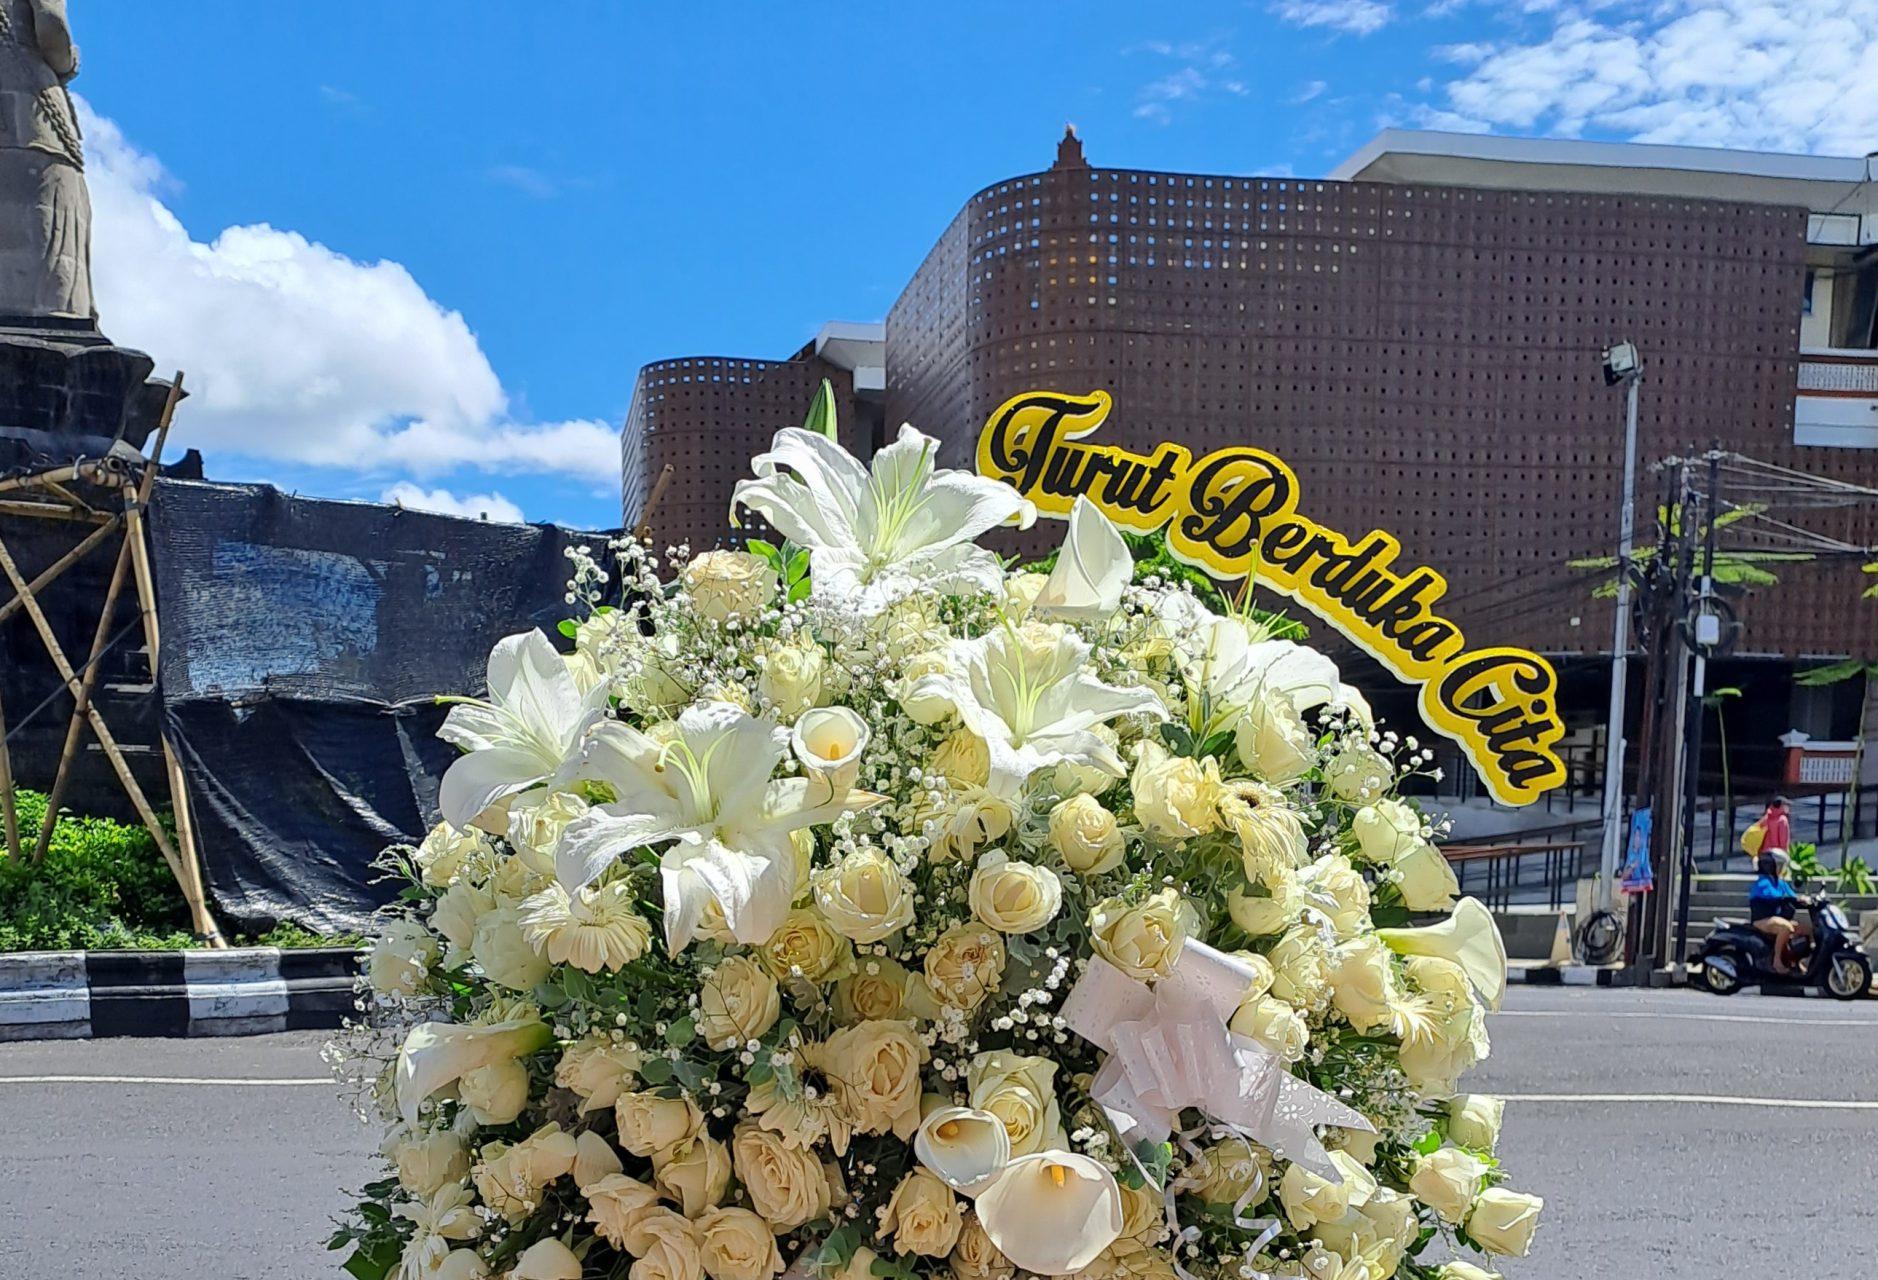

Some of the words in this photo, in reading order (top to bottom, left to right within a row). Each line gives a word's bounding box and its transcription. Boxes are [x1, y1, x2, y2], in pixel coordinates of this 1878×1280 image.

[990, 396, 1179, 514] Turut
[1182, 456, 1454, 663] Berduka
[1440, 655, 1557, 790] Cita
